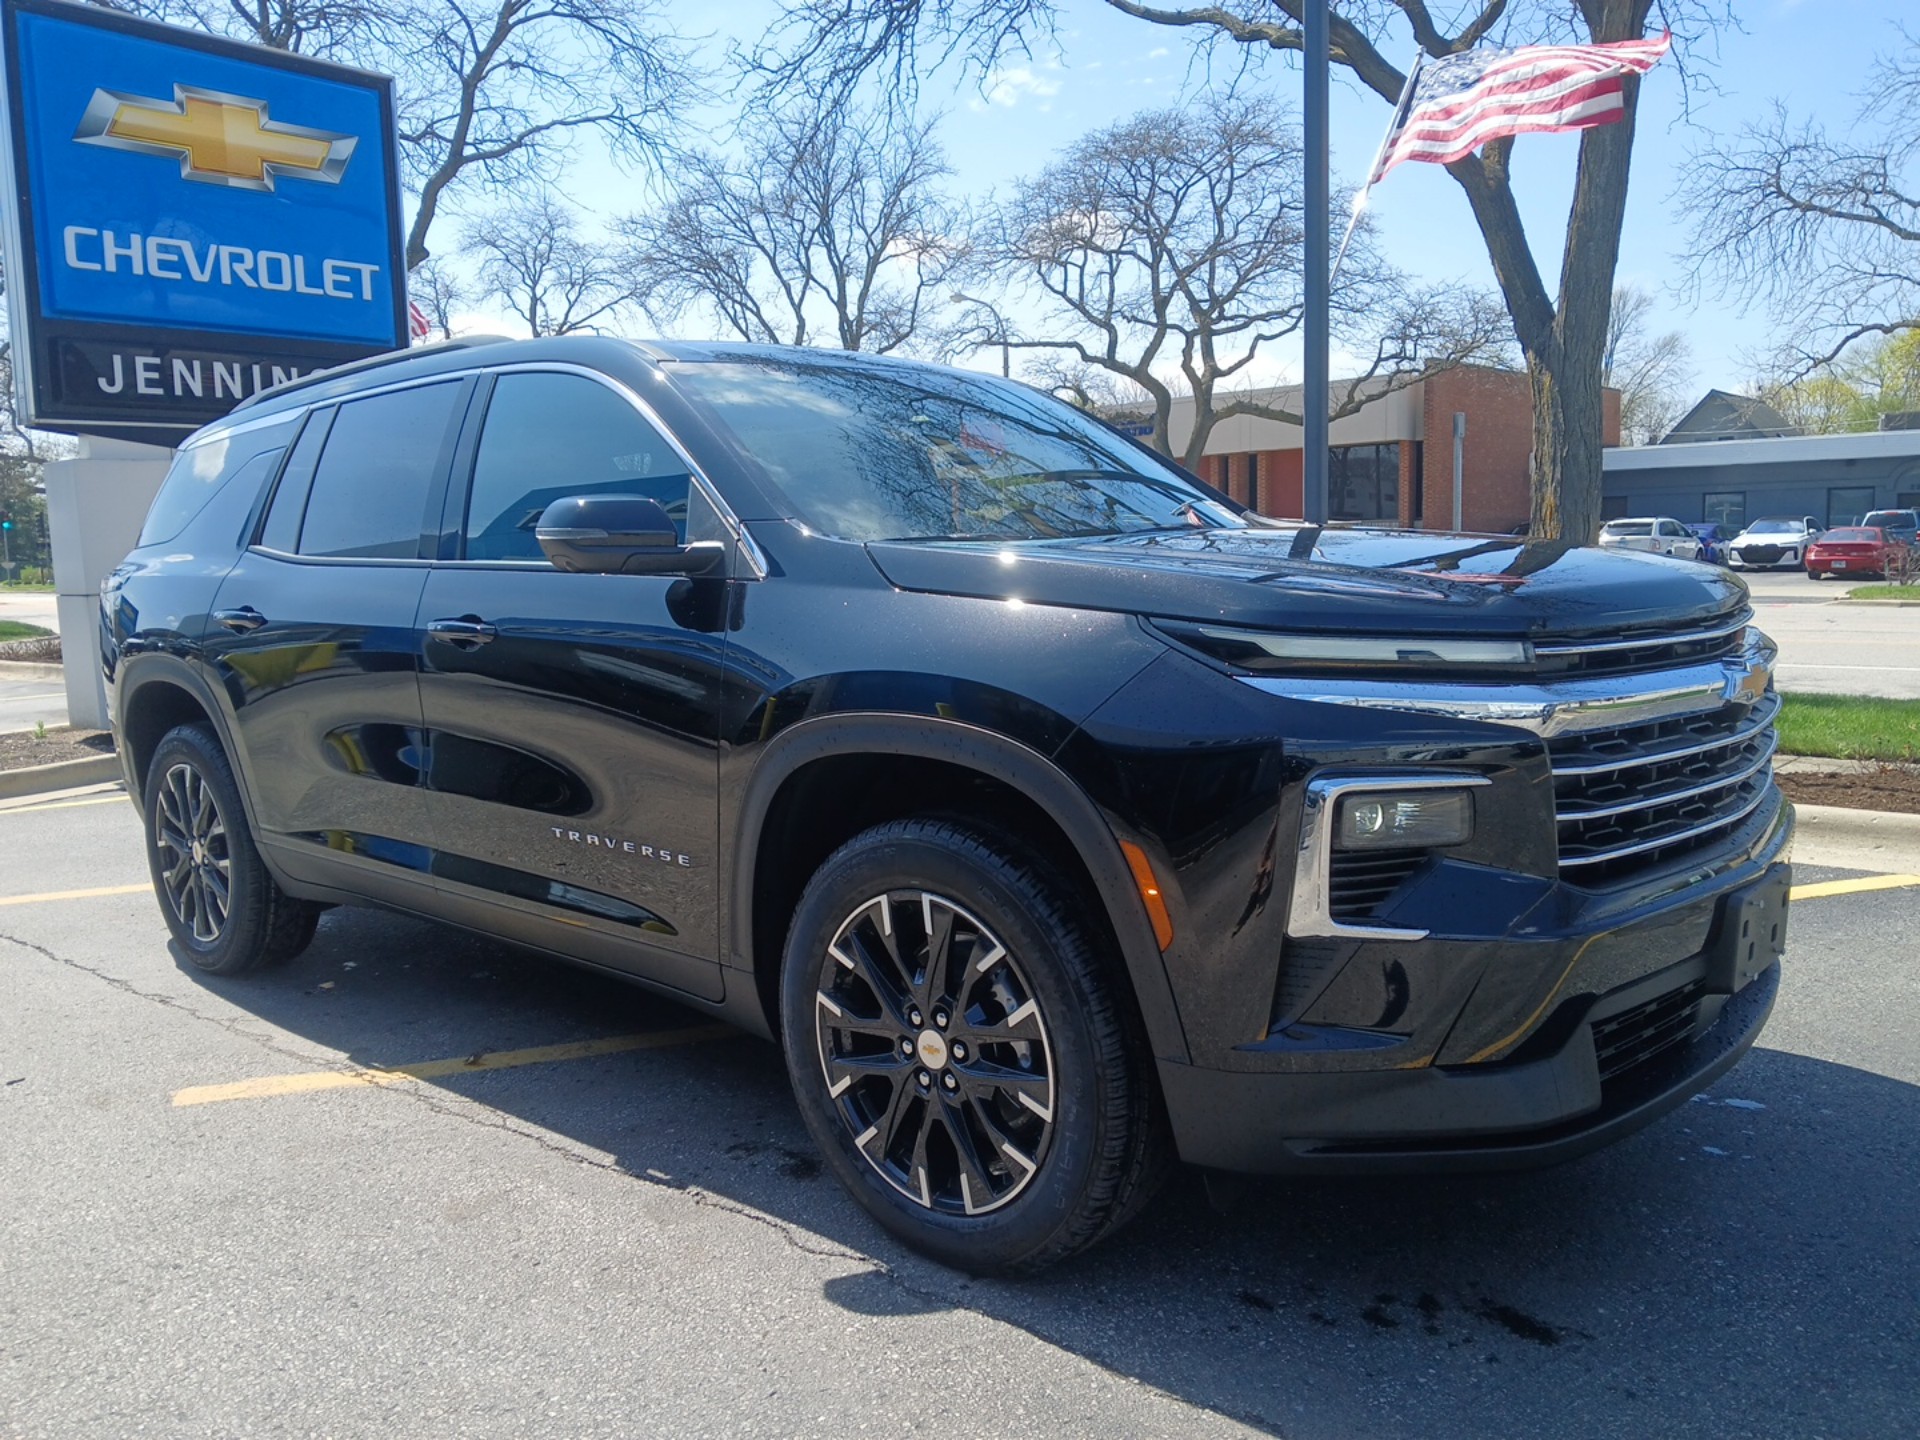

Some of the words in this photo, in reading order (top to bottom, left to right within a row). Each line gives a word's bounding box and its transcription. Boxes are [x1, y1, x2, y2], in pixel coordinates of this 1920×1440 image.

[63, 225, 380, 300] CHEVROLET
[97, 354, 327, 400] JENNI
[551, 827, 690, 867] TRAVERSE
